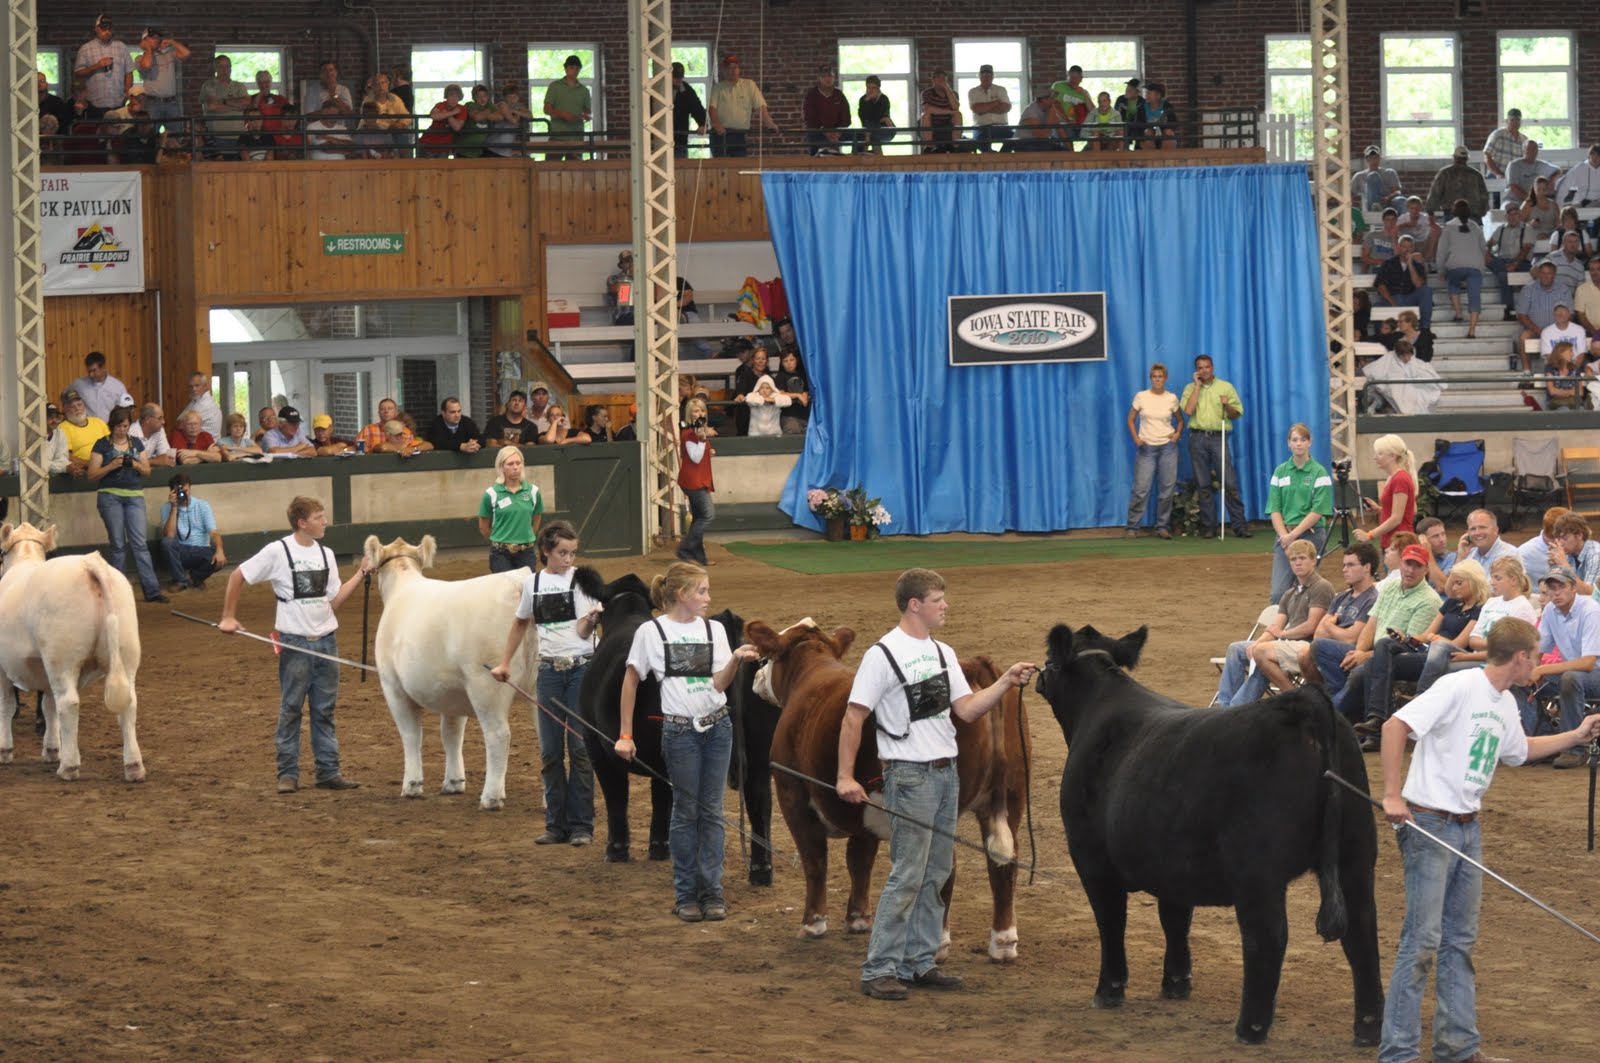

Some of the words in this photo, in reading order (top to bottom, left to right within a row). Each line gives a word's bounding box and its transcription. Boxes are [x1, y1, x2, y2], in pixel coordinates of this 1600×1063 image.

[41, 179, 70, 192] FAIR
[63, 199, 132, 217] PAVILION
[337, 238, 392, 251] RESTROOMS
[61, 252, 91, 263] PRAIRIE
[93, 250, 128, 262] MEADOWS
[970, 313, 1003, 332] IOWA
[1007, 310, 1050, 329] STATE
[1054, 311, 1087, 328] FAIR
[1008, 331, 1050, 346] 2010
